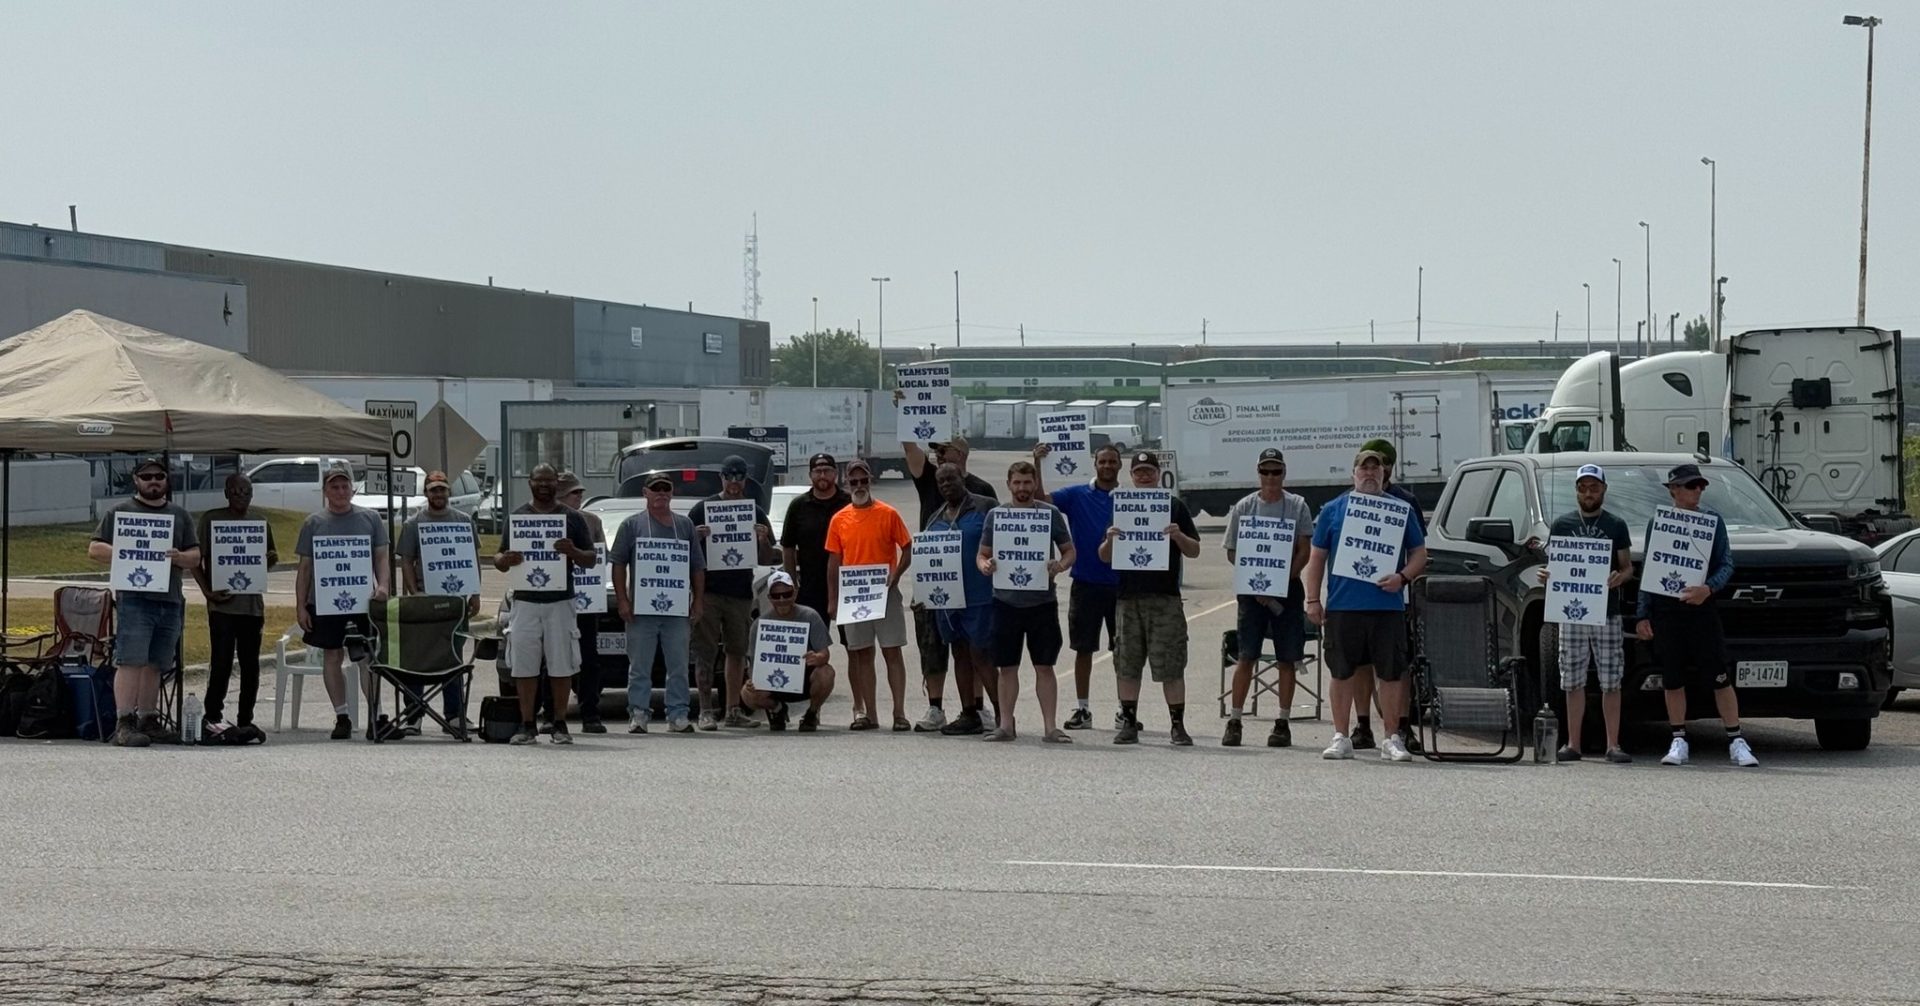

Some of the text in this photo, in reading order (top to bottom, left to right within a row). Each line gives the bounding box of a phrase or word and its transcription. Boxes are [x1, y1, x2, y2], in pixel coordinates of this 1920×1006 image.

[898, 367, 949, 376] TEAMSTERS
[899, 379, 949, 388] LOCAL 938
[918, 392, 932, 400] ON
[903, 405, 946, 415] STRIKE
[1262, 404, 1280, 412] MILE
[1492, 404, 1545, 419] acki
[369, 408, 413, 419] MAXIMUM
[1040, 414, 1086, 424] TEAMSTERS
[1041, 425, 1068, 433] LOCAL
[1058, 433, 1070, 441] ON
[392, 430, 412, 458] 0
[1046, 441, 1085, 451] STRIKE
[1162, 470, 1174, 489] 0
[375, 483, 405, 492] TUNS
[707, 504, 753, 513] TEAMSTERS
[1115, 504, 1169, 512] LOCAL 938
[1350, 496, 1408, 514] TEAMSTERS
[709, 514, 753, 523] LOCAL 938
[996, 511, 1050, 520] TEAMSTERS
[1347, 509, 1405, 527] LOCAL 938
[1657, 509, 1716, 528] TEAMSTERS
[118, 517, 171, 528] TEAMSTERS
[512, 520, 564, 528] TEAMSTERS
[1134, 517, 1149, 526] ON
[1240, 520, 1294, 530] TEAMSTERS
[725, 524, 737, 532] ON
[995, 524, 1049, 532] LOCAL 938
[1365, 526, 1381, 536] ON
[1654, 522, 1713, 541] LOCAL 938
[118, 528, 169, 539] LOCAL 938
[545, 530, 562, 538] 938
[712, 533, 751, 543] STRIKE
[913, 534, 961, 543] TEAMSTERS
[1118, 531, 1164, 541] STRIKE
[1239, 531, 1292, 542] LOCAL 938
[136, 540, 150, 548] ON
[314, 538, 369, 547] TEAMSTERS
[421, 537, 450, 545] LOCAL
[532, 541, 544, 549] ON
[637, 541, 688, 551] TEAMSTERS
[1014, 537, 1029, 546] ON
[1551, 539, 1610, 551] TEAMSTERS
[1673, 540, 1689, 550] ON
[233, 546, 246, 554] ON
[913, 546, 940, 555] LOCAL
[1256, 544, 1271, 553] ON
[1345, 537, 1395, 556] STRIKE
[119, 550, 166, 561] STRIKE
[315, 550, 370, 560] LOCAL 938
[441, 548, 456, 556] ON
[524, 552, 560, 561] TRIKE
[998, 551, 1044, 561] STRIKE
[218, 556, 261, 565] STRIKE
[637, 553, 688, 562] LOCAL 938
[1240, 557, 1286, 568] STRIKE
[1550, 553, 1609, 564] LOCAL 938
[1652, 551, 1703, 570] STRIKE
[336, 563, 351, 571] ON
[428, 560, 473, 571] STRIKE
[930, 559, 942, 567] ON
[656, 566, 670, 574] ON
[841, 568, 887, 578] TEAMSTERS
[1570, 568, 1586, 578] ON
[320, 576, 368, 587] STRIKE
[574, 576, 602, 586] RIKE
[842, 578, 868, 586] LOCAL
[916, 572, 958, 582] STRIKE
[640, 579, 684, 589] STRIKE
[1552, 582, 1603, 594] STRIKE
[844, 593, 882, 604] STRIKE
[760, 624, 806, 634] TEAMSTERS
[760, 634, 804, 644] LOCAL 938
[760, 653, 800, 665] STRIKE
[1738, 668, 1784, 680] BP 14741
